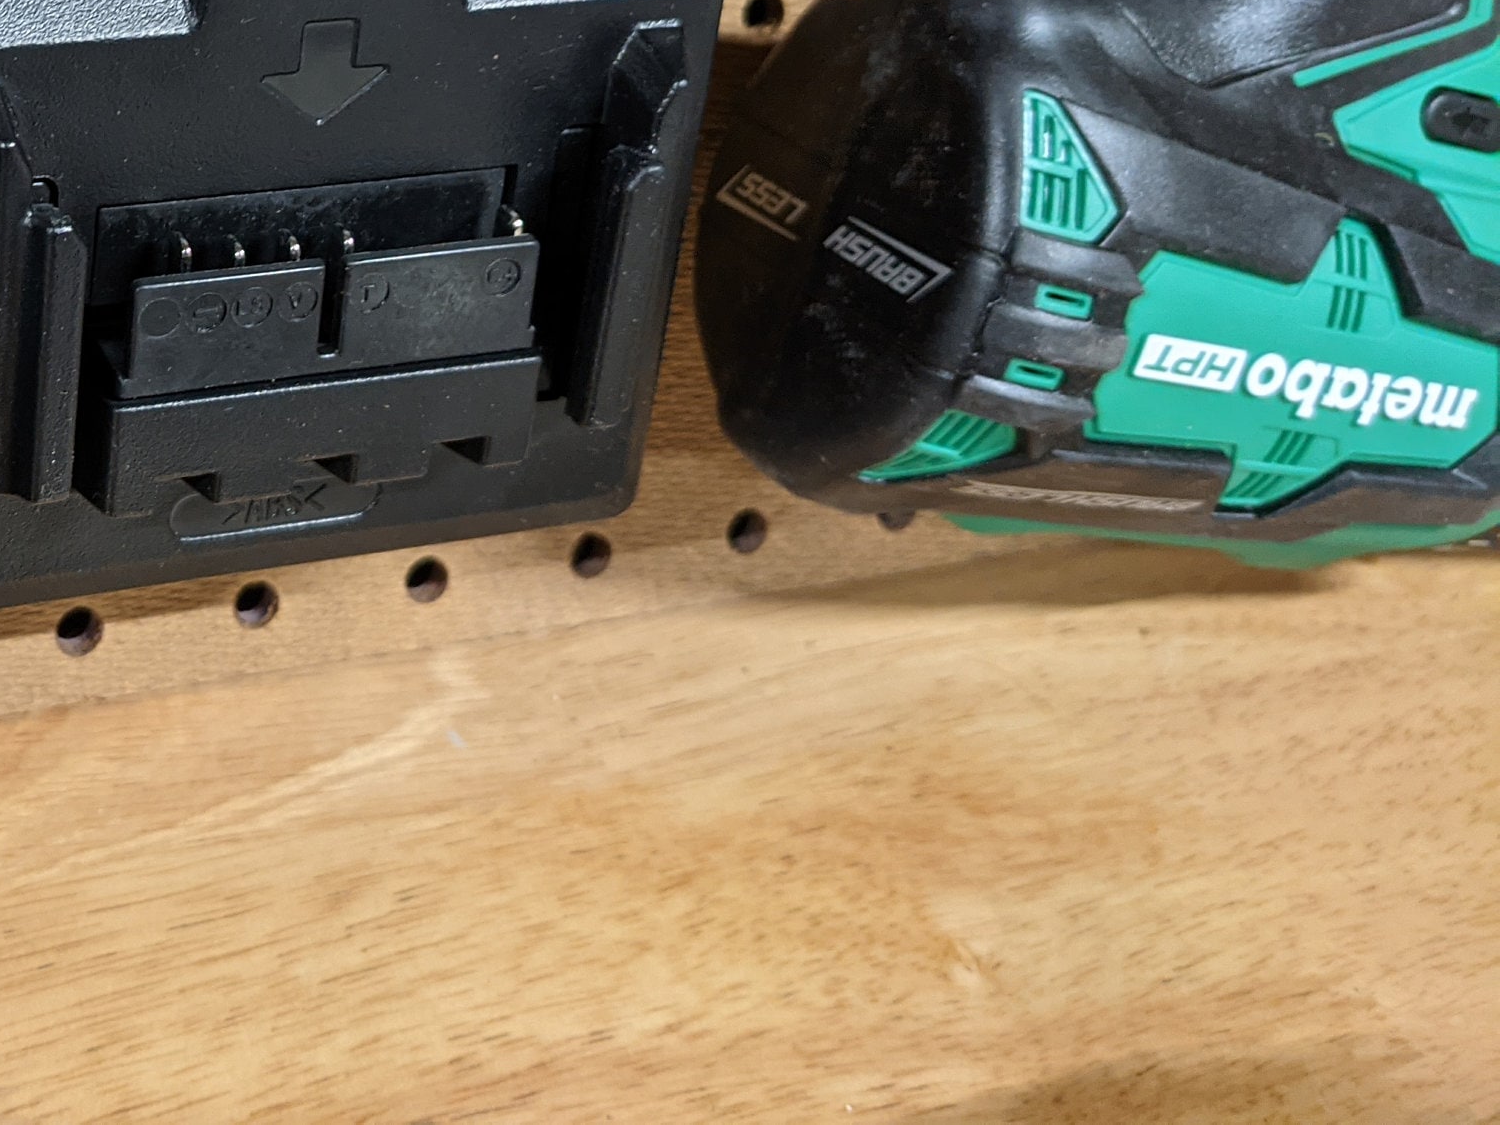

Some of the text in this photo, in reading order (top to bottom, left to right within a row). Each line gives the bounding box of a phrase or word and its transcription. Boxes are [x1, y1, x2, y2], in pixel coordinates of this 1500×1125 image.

[734, 172, 806, 224] LESS
[823, 225, 927, 295] BRUSH
[1141, 344, 1479, 428] metabo HPT
